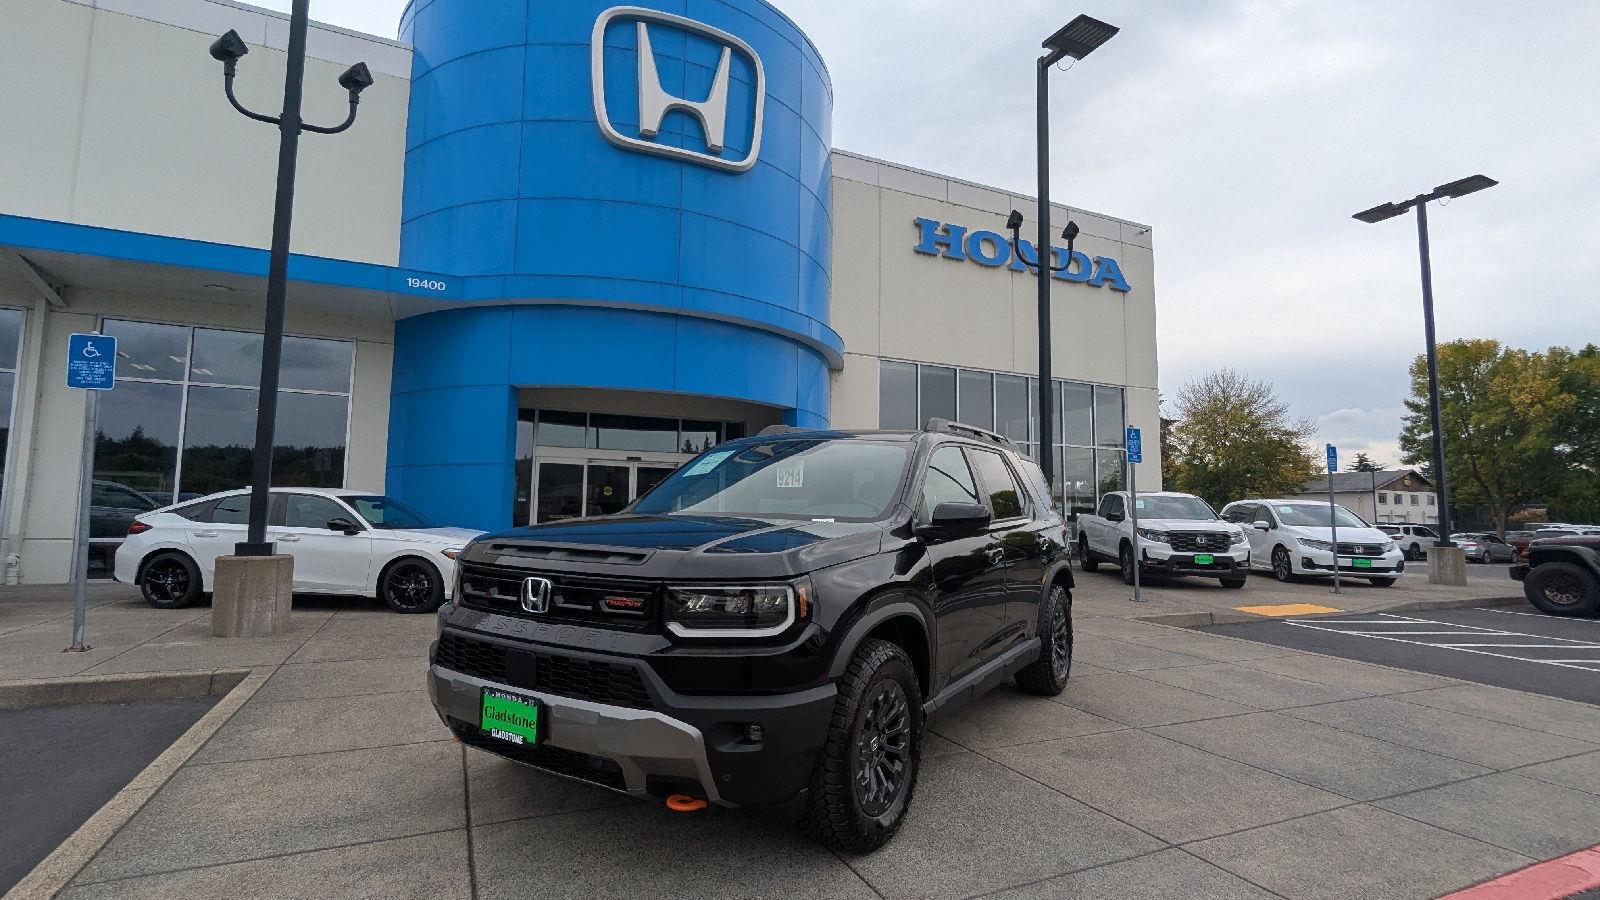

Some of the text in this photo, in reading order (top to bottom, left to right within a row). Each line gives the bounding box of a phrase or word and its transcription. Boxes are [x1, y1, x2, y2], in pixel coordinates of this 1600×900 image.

[914, 217, 1132, 293] HONDA
[407, 277, 446, 291] 19400
[778, 469, 801, 487] 9214
[484, 705, 536, 730] Gladstone
[491, 728, 524, 745] GLADSTONE
